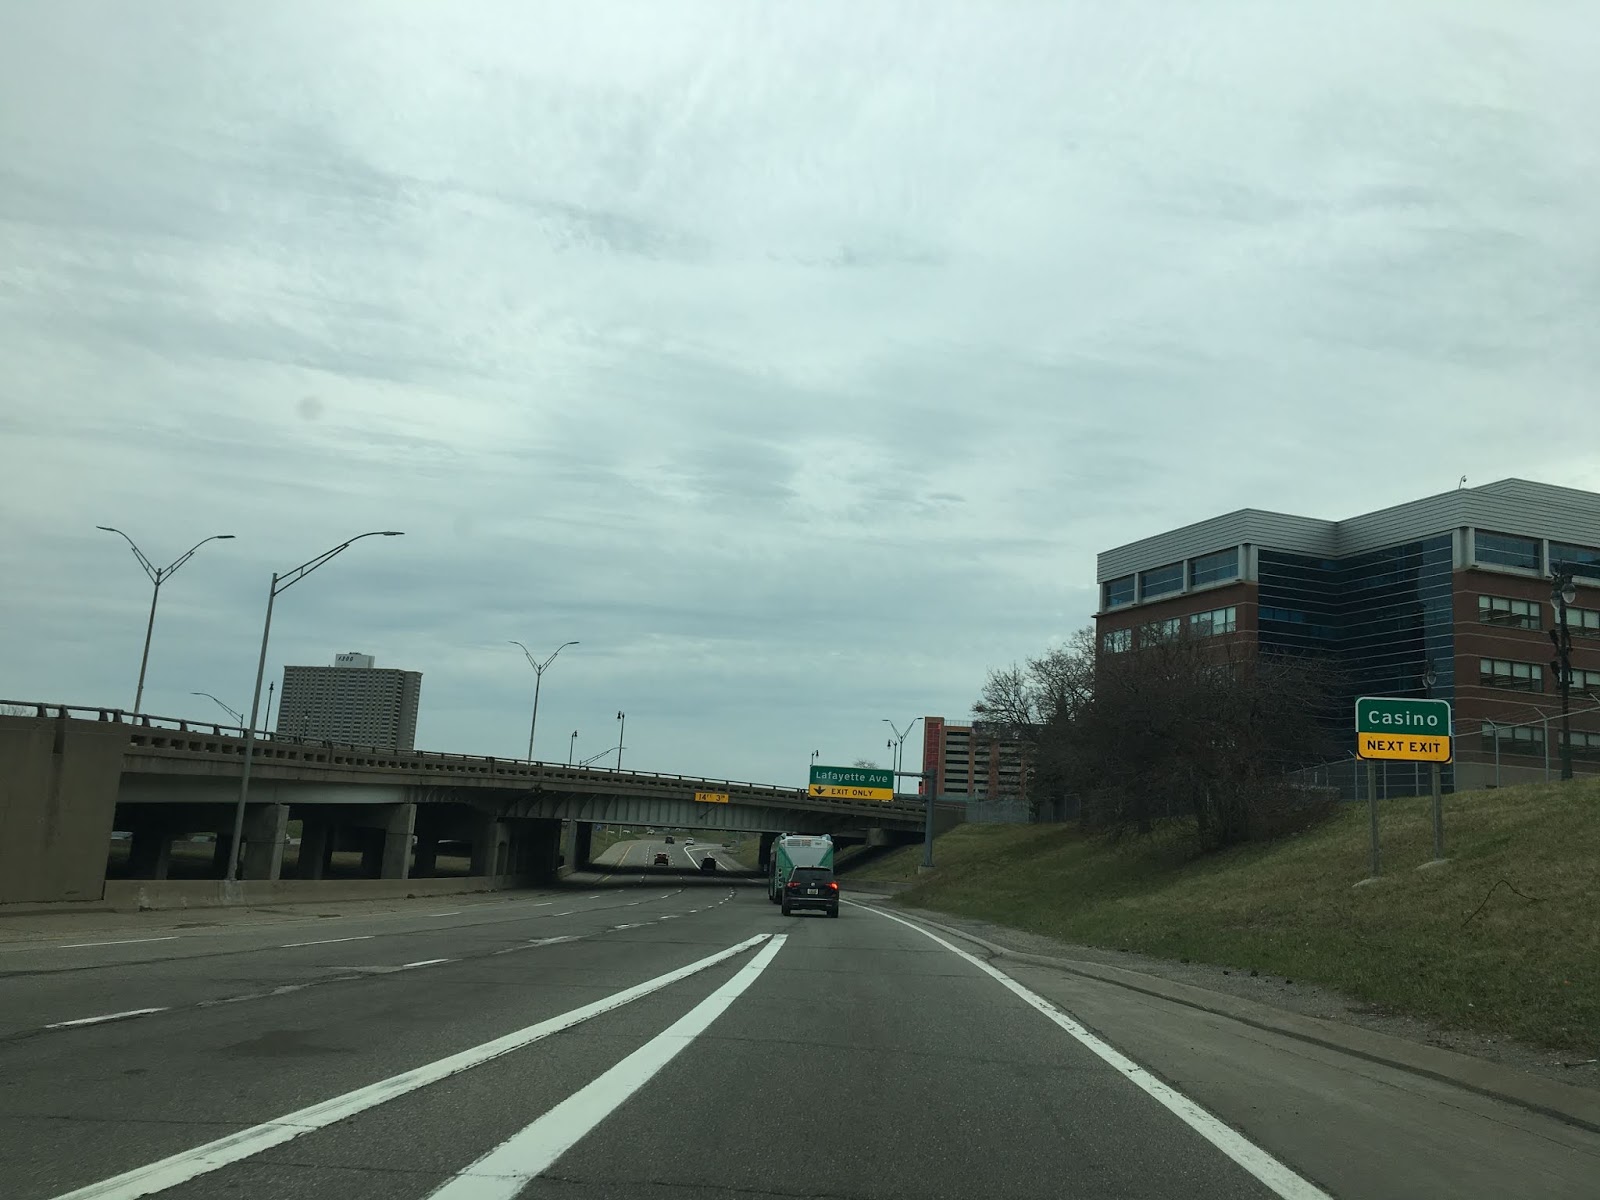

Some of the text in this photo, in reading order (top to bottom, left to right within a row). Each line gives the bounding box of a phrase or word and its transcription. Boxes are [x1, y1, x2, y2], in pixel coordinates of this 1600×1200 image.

[1368, 710, 1438, 727] Casino
[1367, 740, 1440, 753] NEXT EXIT
[816, 771, 888, 783] Lafayette Ave
[852, 789, 873, 797] ONLY
